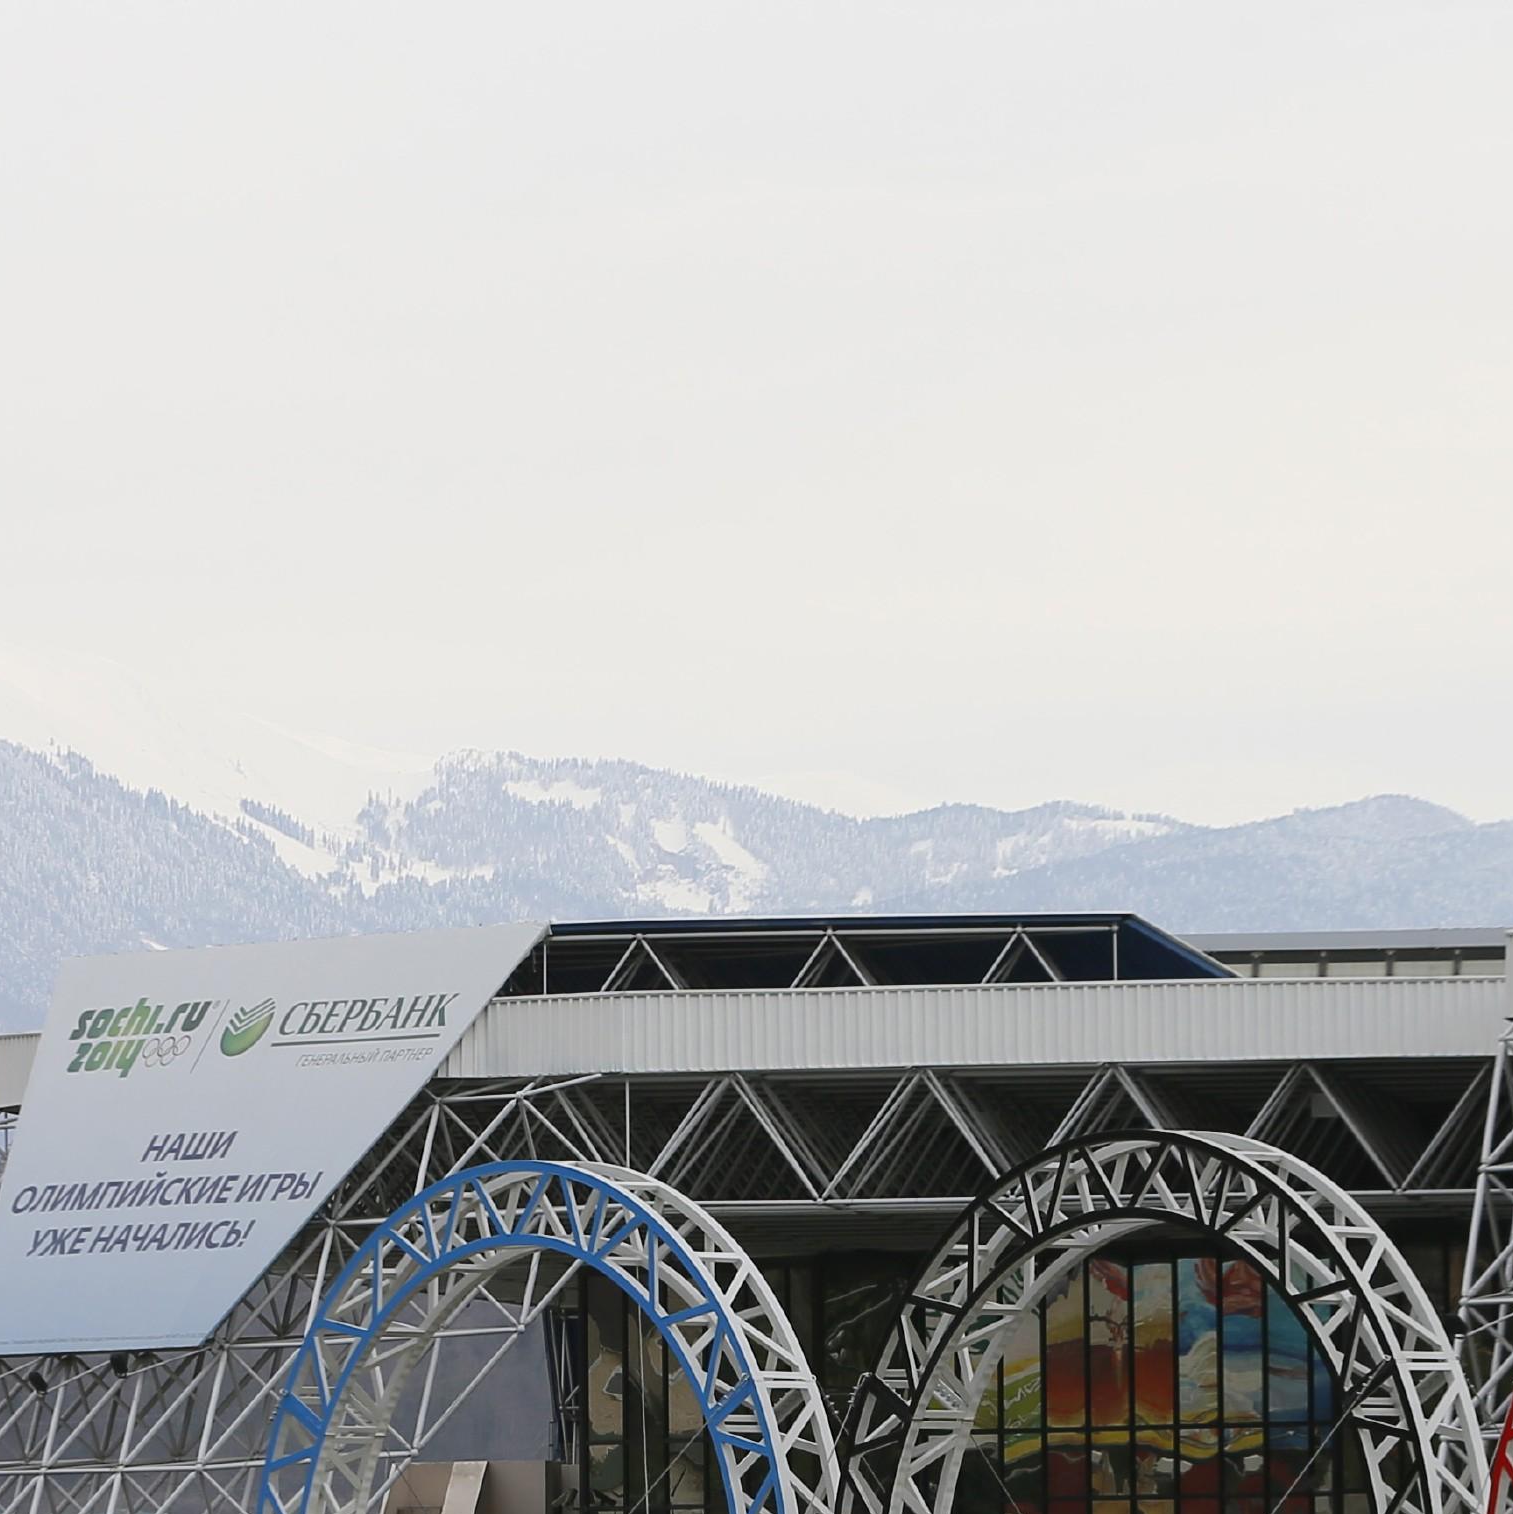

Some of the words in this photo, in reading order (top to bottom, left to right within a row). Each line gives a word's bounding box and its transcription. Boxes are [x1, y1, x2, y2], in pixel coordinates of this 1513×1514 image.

[68, 997, 213, 1040] sochi.ru
[278, 992, 460, 1036] СБЕРБАНК
[66, 1038, 147, 1078] 2014
[295, 1048, 380, 1067] ГЕНЕРАЛЬНЫЙ
[380, 1047, 434, 1063] ПАРТНЕР
[140, 1130, 238, 1162] НАШИ
[11, 1171, 240, 1214] ОЛИМПИЙСКИЕ
[236, 1171, 323, 1203] ИГРЫ
[26, 1226, 92, 1257] УЖЕ
[88, 1219, 256, 1254] НАЧАЛИСЬ!
